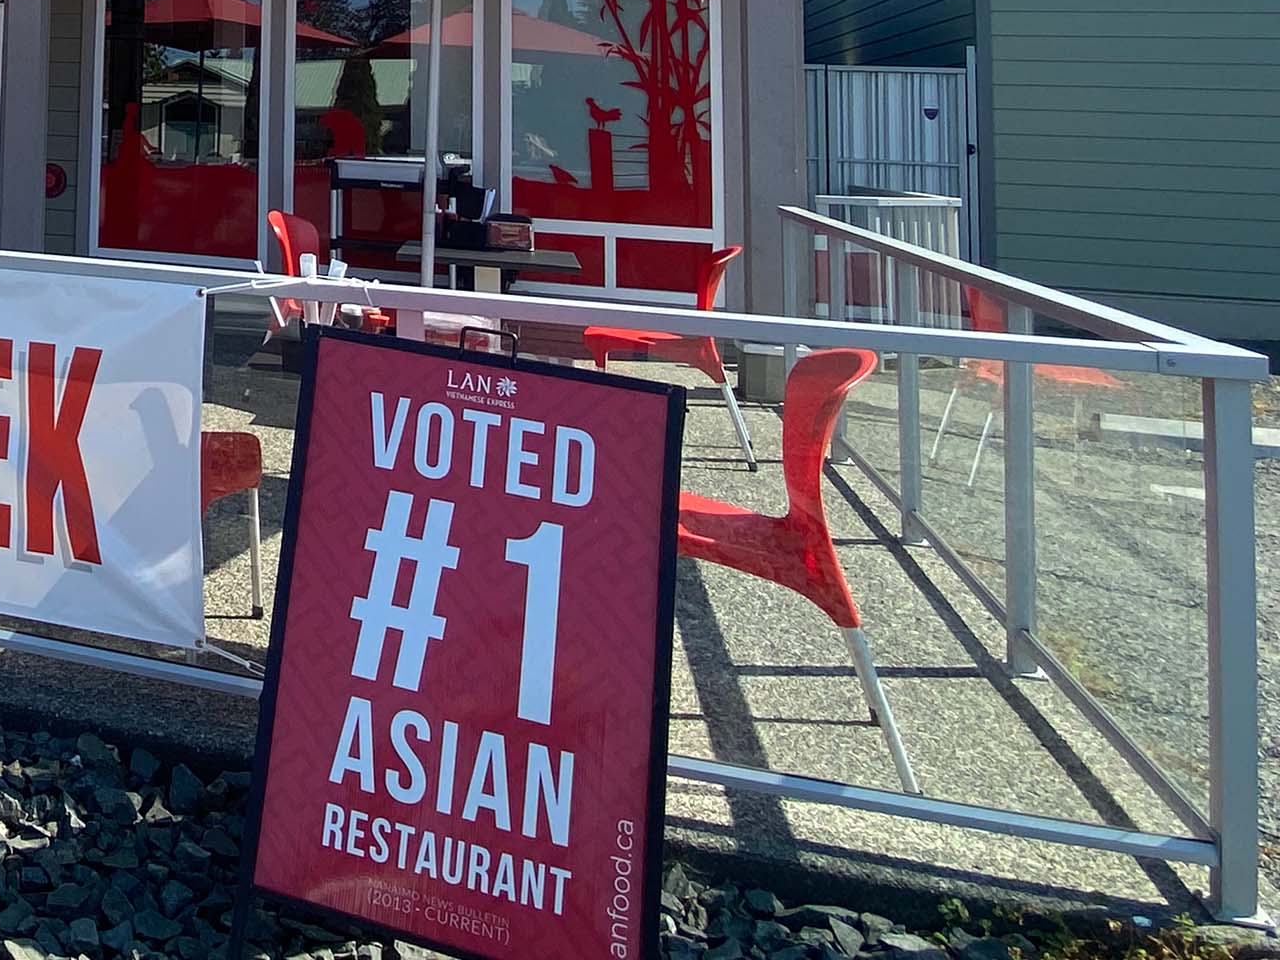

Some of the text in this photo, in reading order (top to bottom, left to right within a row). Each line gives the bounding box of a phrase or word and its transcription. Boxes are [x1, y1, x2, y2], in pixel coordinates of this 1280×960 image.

[447, 369, 491, 393] LAN
[447, 391, 515, 409] VIETNAMESE EXPRESS
[370, 391, 597, 508] VOTED
[328, 695, 576, 848] ASIAN
[321, 801, 574, 916] RESTAURANT
[422, 894, 455, 913] NEWS
[456, 904, 511, 929] BULLETIN
[423, 905, 512, 946] CURRENT)
